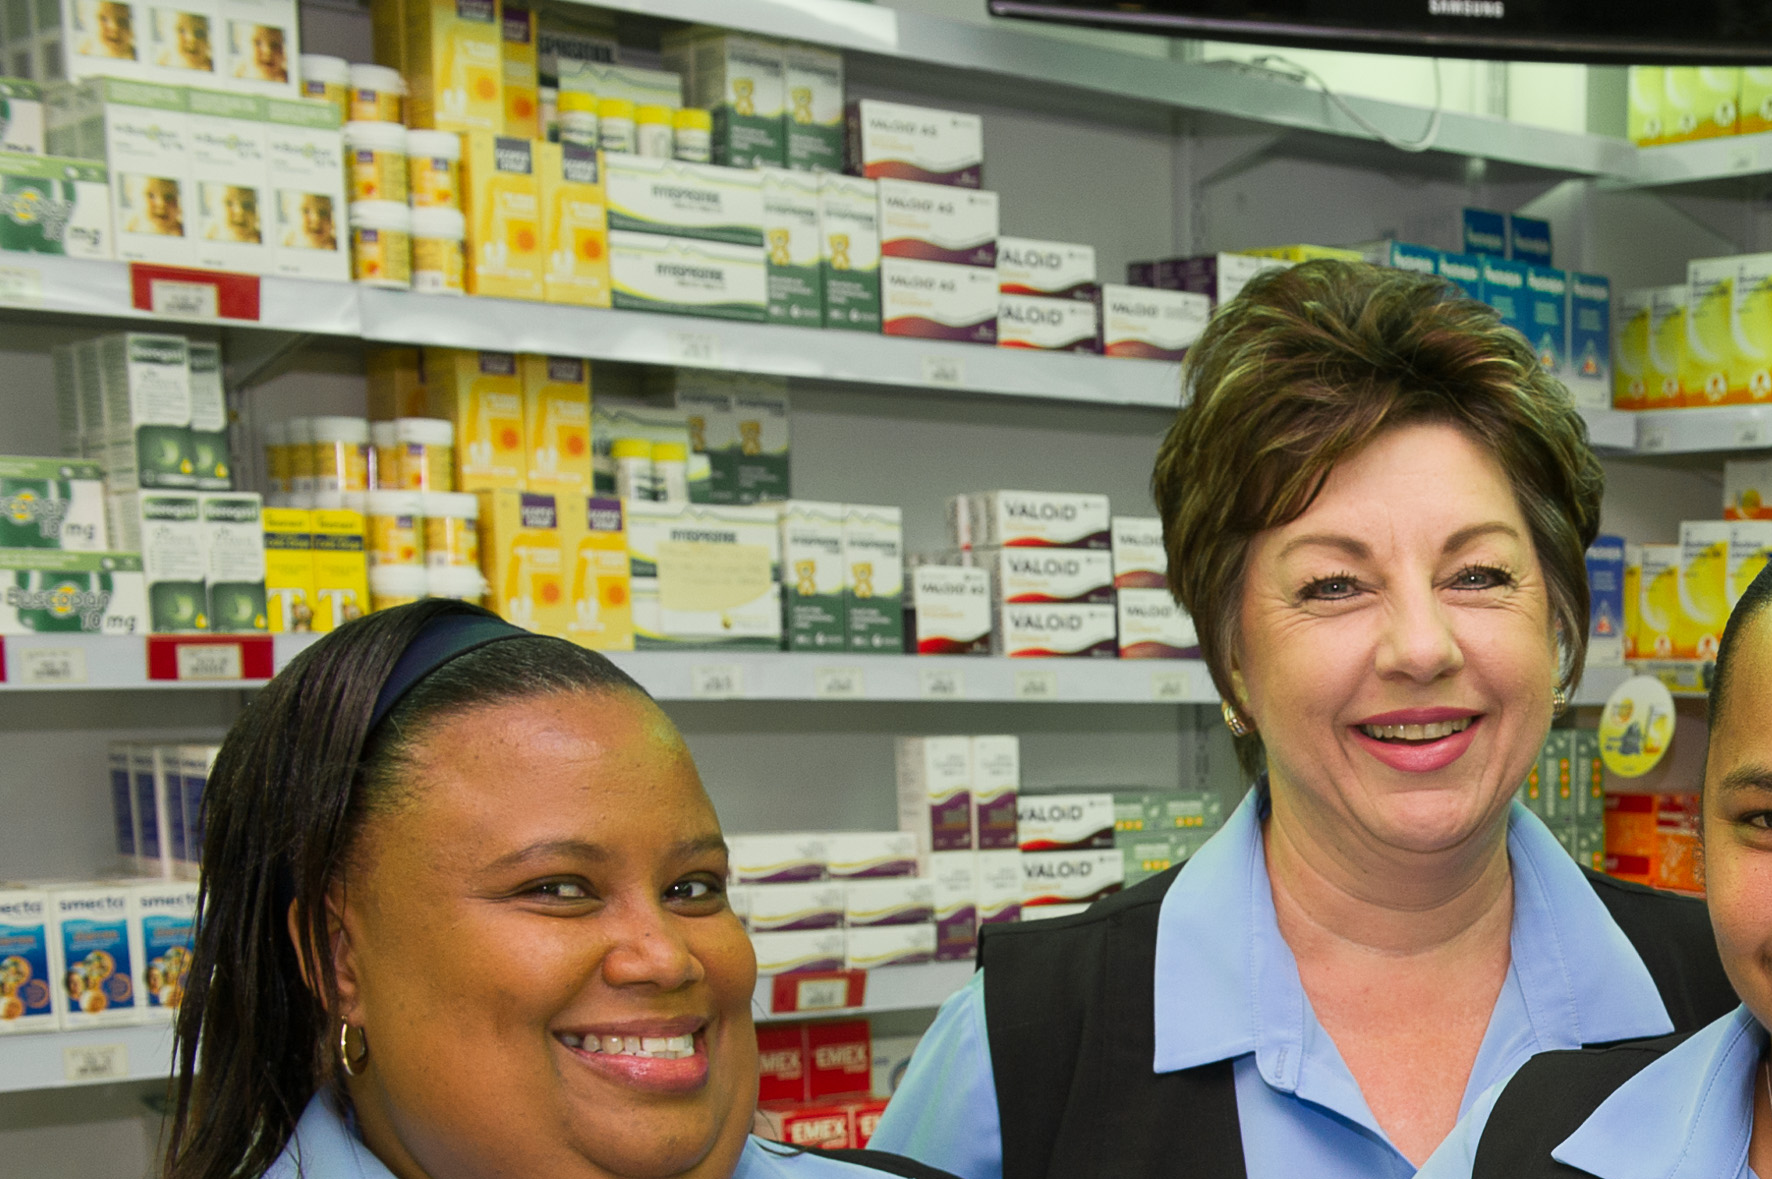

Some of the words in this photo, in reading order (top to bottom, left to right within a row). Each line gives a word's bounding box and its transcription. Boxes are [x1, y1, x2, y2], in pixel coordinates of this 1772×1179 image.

[1428, 0, 1505, 18] SAMSUNG
[1004, 500, 1077, 522] VALOID
[40, 517, 60, 539] 10
[66, 523, 95, 540] mg
[1008, 556, 1081, 577] VALOID
[7, 586, 111, 611] Buscopan
[81, 610, 101, 630] 10
[106, 615, 136, 631] mg
[1010, 611, 1083, 631] VALOID
[1024, 861, 1093, 878] VALOID
[0, 902, 42, 914] ecta
[60, 896, 125, 911] smecta
[760, 1050, 799, 1073] MEX
[815, 1043, 866, 1069] EMEX
[791, 1118, 846, 1144] EMEX
